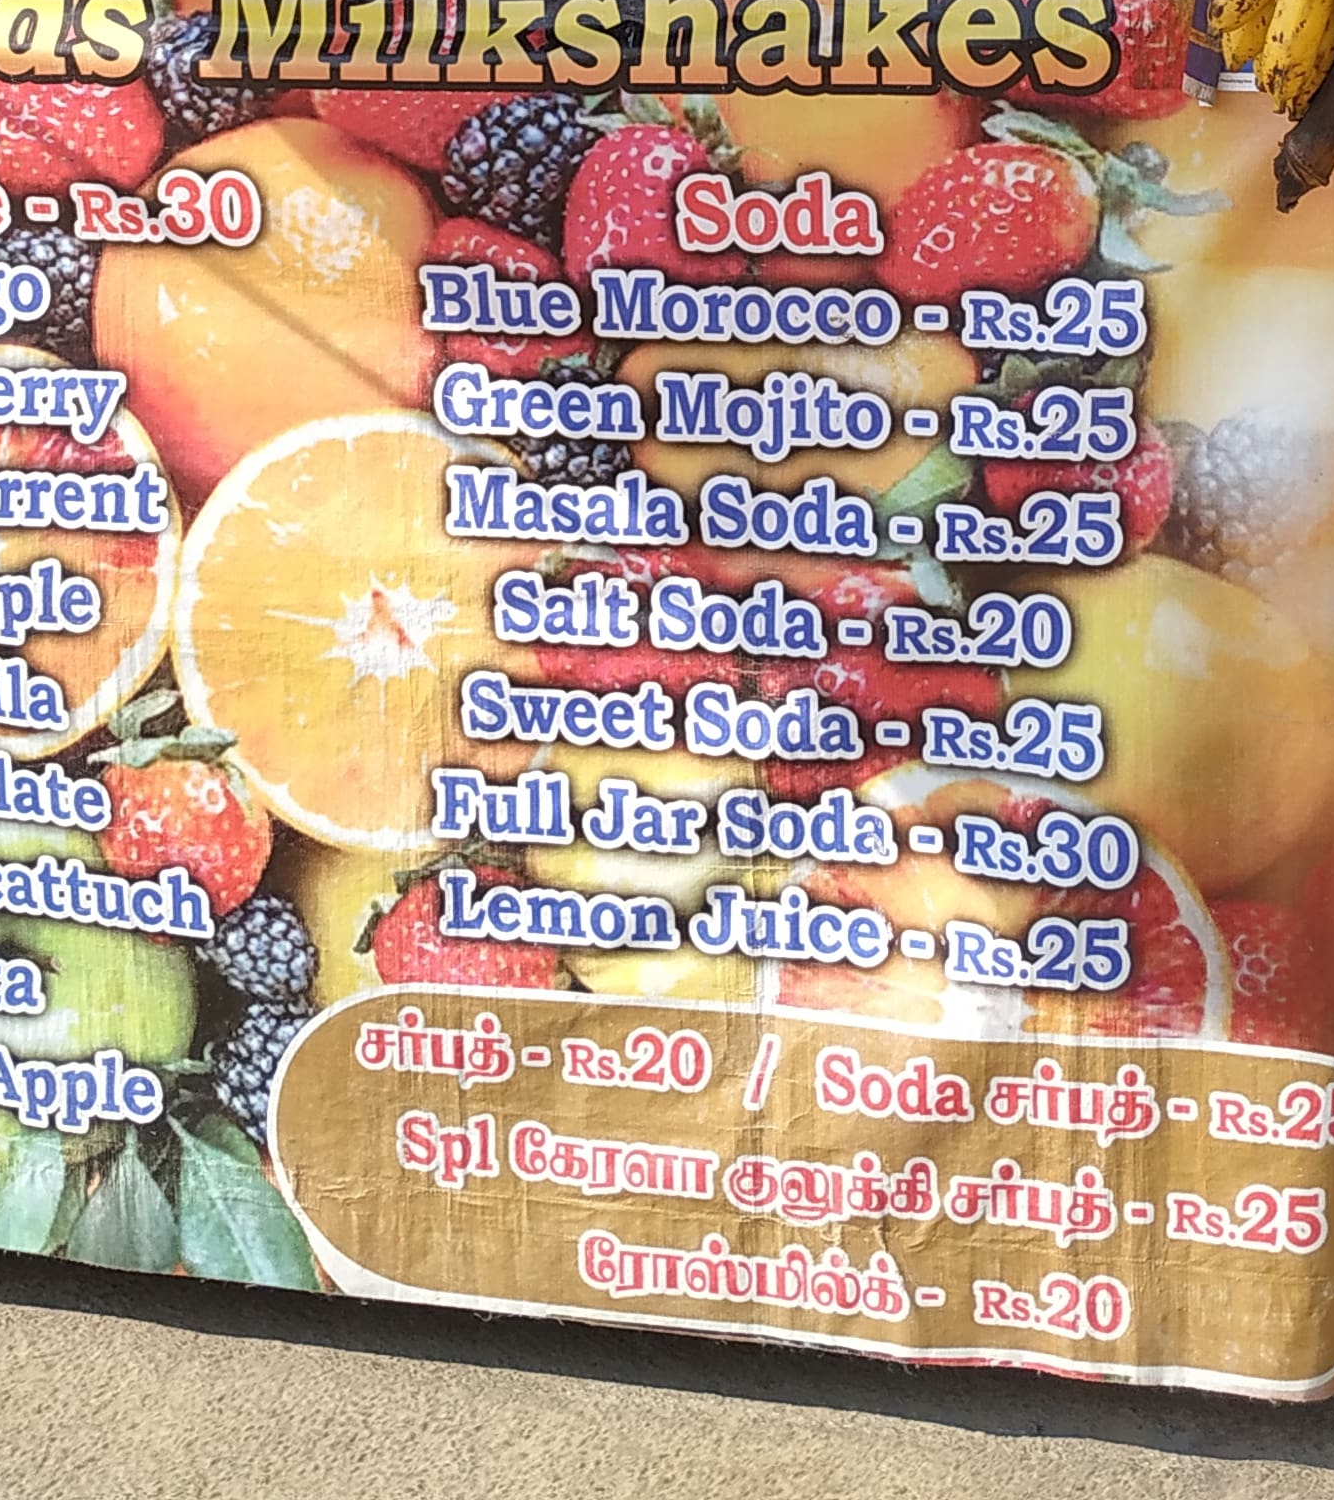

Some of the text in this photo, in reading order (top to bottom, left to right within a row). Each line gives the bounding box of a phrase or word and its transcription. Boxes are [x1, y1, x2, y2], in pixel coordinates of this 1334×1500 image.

[76, 175, 255, 241] Rs.30
[682, 177, 878, 249] Soda
[425, 270, 574, 330] Blue
[598, 275, 894, 339] Morocco
[968, 285, 1140, 350] Rs.25
[441, 371, 638, 434] Green
[662, 378, 885, 456] Mojito
[957, 393, 1129, 455] Rs.25
[453, 473, 682, 539] Masala
[706, 482, 870, 546] Soda
[942, 497, 1116, 559] Rs.25
[501, 578, 631, 640] Salt
[657, 583, 821, 652] Soda
[891, 599, 1065, 661] Rs.20
[468, 678, 667, 743] Sweet
[693, 689, 857, 754] Soda
[929, 705, 1097, 774] Rs.25
[439, 775, 567, 838] Full
[589, 787, 700, 847] Jar
[725, 795, 885, 855] Soda
[961, 818, 1132, 883] Rs.30
[445, 875, 673, 942] Lemon
[695, 891, 880, 959] Juice
[955, 923, 1124, 984] Rs.25
[361, 1011, 510, 1080] சர்பத்
[567, 1032, 706, 1087] Rs.20
[822, 1054, 969, 1118] Soda
[989, 1064, 1154, 1137] சர்பத்
[402, 1116, 493, 1183] Spl
[514, 1126, 712, 1194] கேரளா
[728, 1156, 934, 1221] குலுக்கி
[950, 1163, 1112, 1238] சர்பத்
[1173, 1190, 1323, 1248] Rs.25
[584, 1236, 903, 1314] ரோஸ்மில்க்
[980, 1279, 1123, 1334] Rs.20
